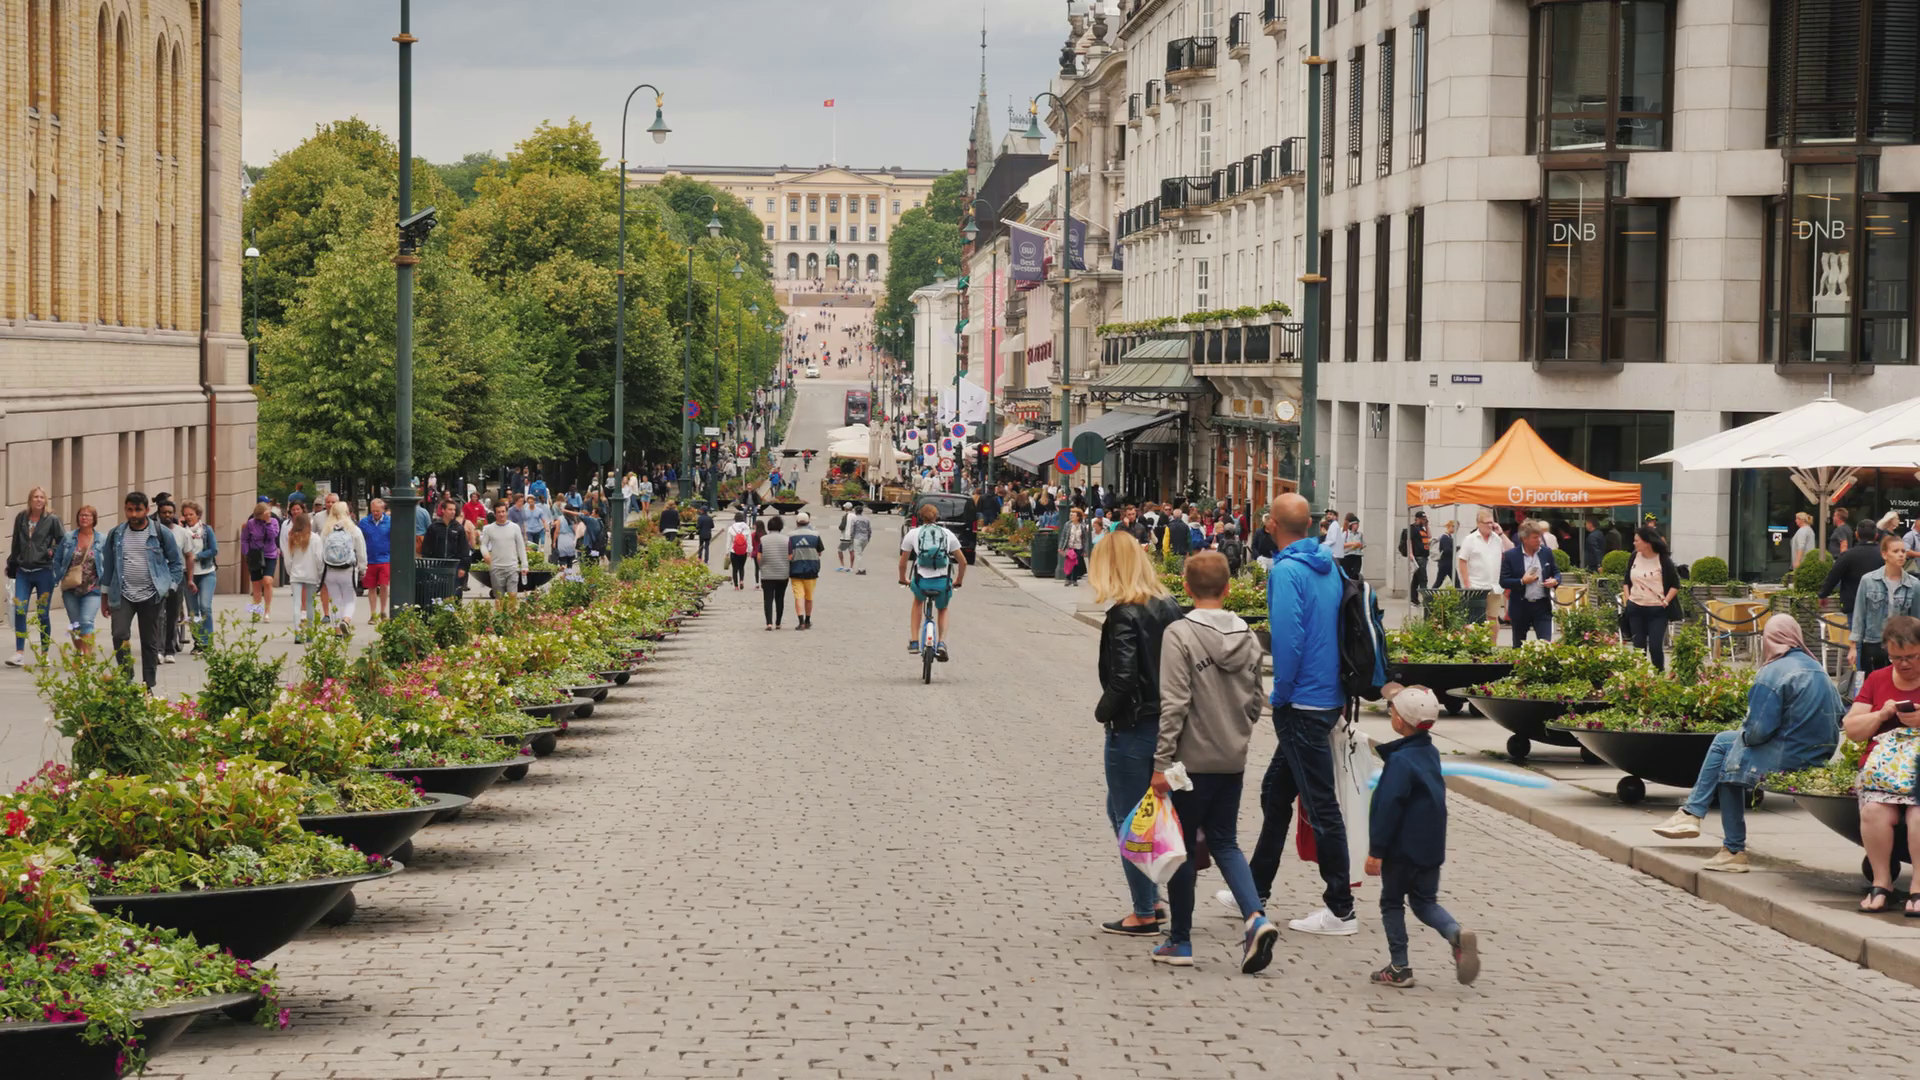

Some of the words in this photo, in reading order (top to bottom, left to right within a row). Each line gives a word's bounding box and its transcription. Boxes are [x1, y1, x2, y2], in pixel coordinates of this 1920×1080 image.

[1180, 229, 1205, 245] OTEL
[1553, 222, 1596, 242] DNB
[1799, 220, 1846, 240] DNB
[1525, 489, 1589, 503] Fjordkraft
